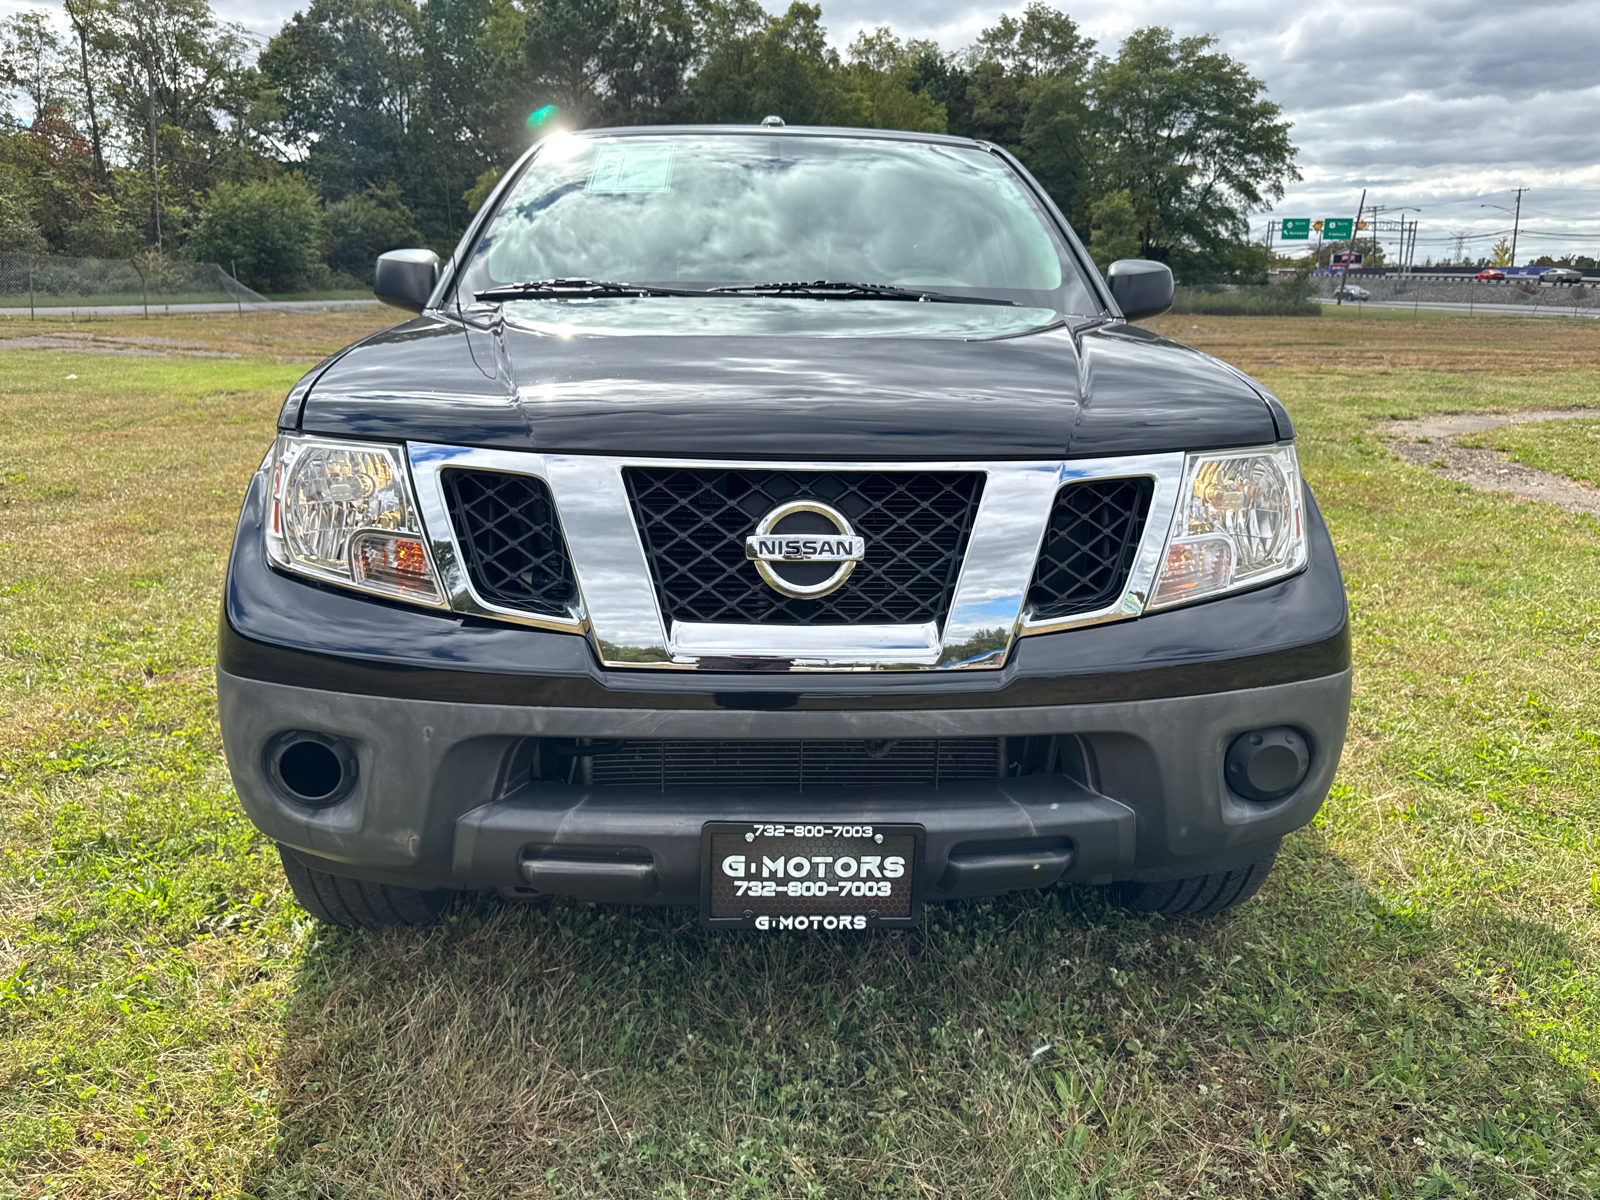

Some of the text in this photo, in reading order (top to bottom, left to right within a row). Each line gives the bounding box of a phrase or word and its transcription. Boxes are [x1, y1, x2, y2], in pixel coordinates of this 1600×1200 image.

[758, 540, 853, 556] NISSAN
[753, 824, 873, 838] 732-800-7003
[733, 880, 892, 897] 732-800-7003
